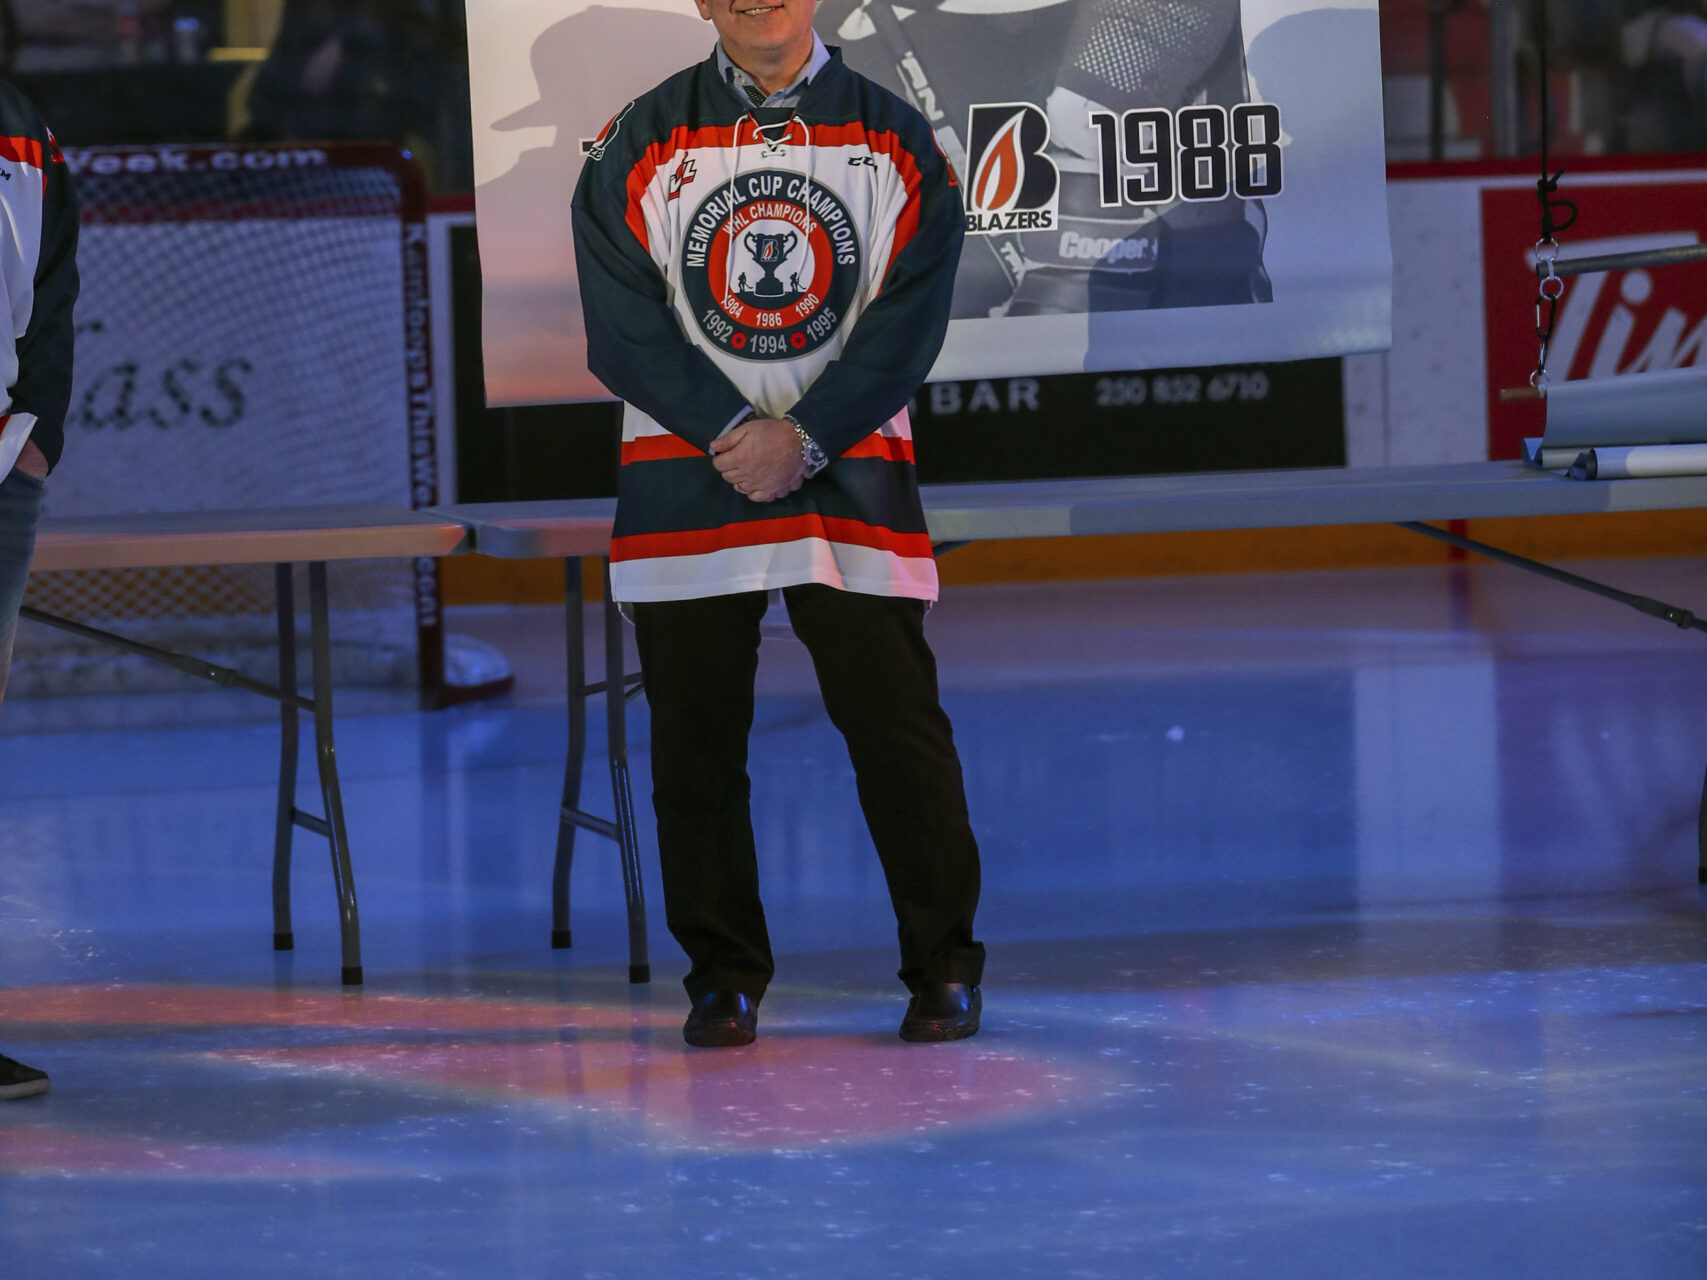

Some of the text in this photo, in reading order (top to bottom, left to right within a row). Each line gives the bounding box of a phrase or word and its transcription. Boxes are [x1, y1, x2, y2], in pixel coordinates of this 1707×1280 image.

[1088, 103, 1284, 208] 1988
[686, 185, 747, 267] MEMORIAL
[748, 175, 783, 197] CUP
[786, 178, 856, 265] CHAMPIONS
[722, 202, 818, 237] WHL CHAMPIONS
[965, 209, 1053, 232] BLAZERS
[1058, 230, 1148, 264] Cooper
[721, 293, 820, 327] 1984 1986 1990
[702, 306, 837, 354] 1992 1994 1995
[931, 377, 1041, 414] BAR
